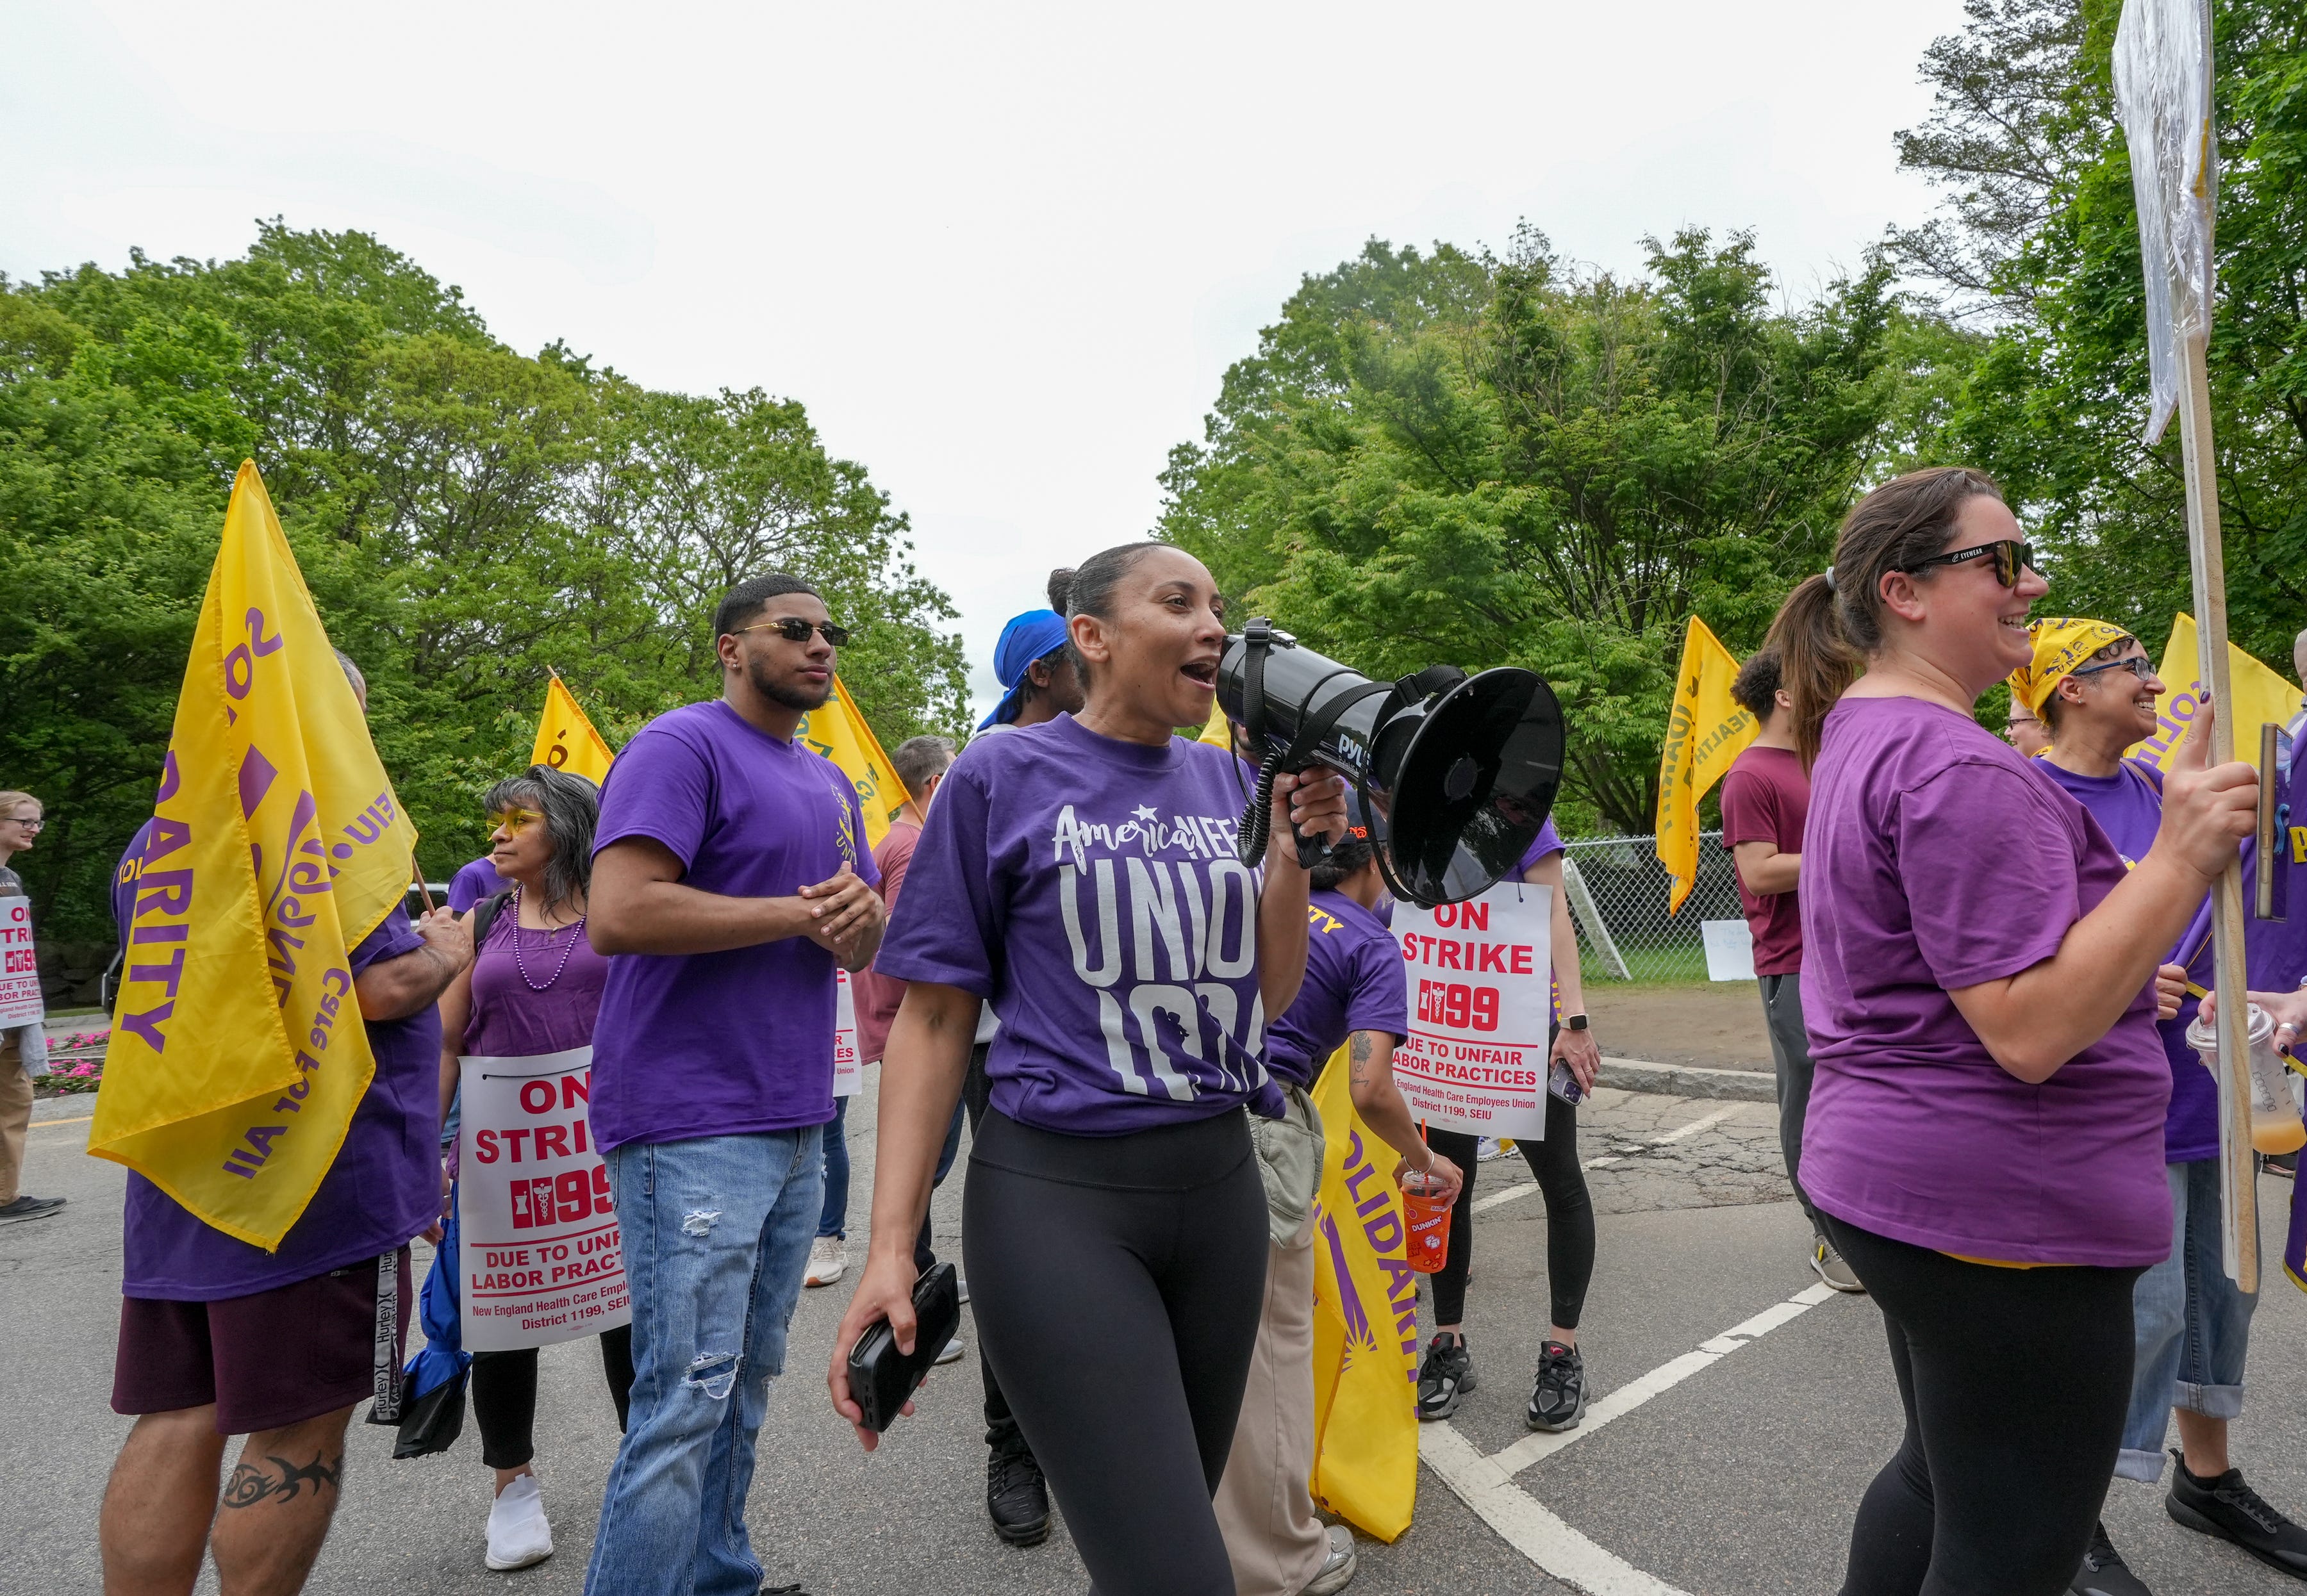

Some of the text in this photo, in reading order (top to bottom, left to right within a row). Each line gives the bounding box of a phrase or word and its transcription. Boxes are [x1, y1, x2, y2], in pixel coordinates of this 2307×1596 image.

[1961, 548, 1983, 559] EYEWEAR
[1052, 804, 1239, 876] America NEE
[1434, 900, 1489, 932] ON
[1402, 932, 1533, 975] STRIKE
[1402, 1037, 1523, 1066] UE TO UNFAIR
[1435, 1061, 1537, 1086] PRACTICES
[520, 1071, 591, 1114] ON
[1396, 1078, 1421, 1094] England
[1423, 1085, 1444, 1099] Health
[1446, 1091, 1464, 1103] Care
[1466, 1094, 1510, 1108] Employees
[1512, 1098, 1536, 1109] Union
[1412, 1096, 1492, 1120] District 1199, SEIU
[1412, 1215, 1443, 1232] DUNKIN'
[486, 1250, 529, 1268] DUE
[536, 1245, 569, 1263] TO
[472, 1270, 545, 1290] LABOR
[472, 1305, 492, 1317] New
[494, 1303, 534, 1318] England
[536, 1296, 570, 1312] Health
[572, 1290, 598, 1304] Care
[522, 1313, 568, 1330] District
[570, 1304, 605, 1320] 1199,
[377, 1306, 392, 1344] Hurley
[376, 1376, 389, 1413] Hurley
